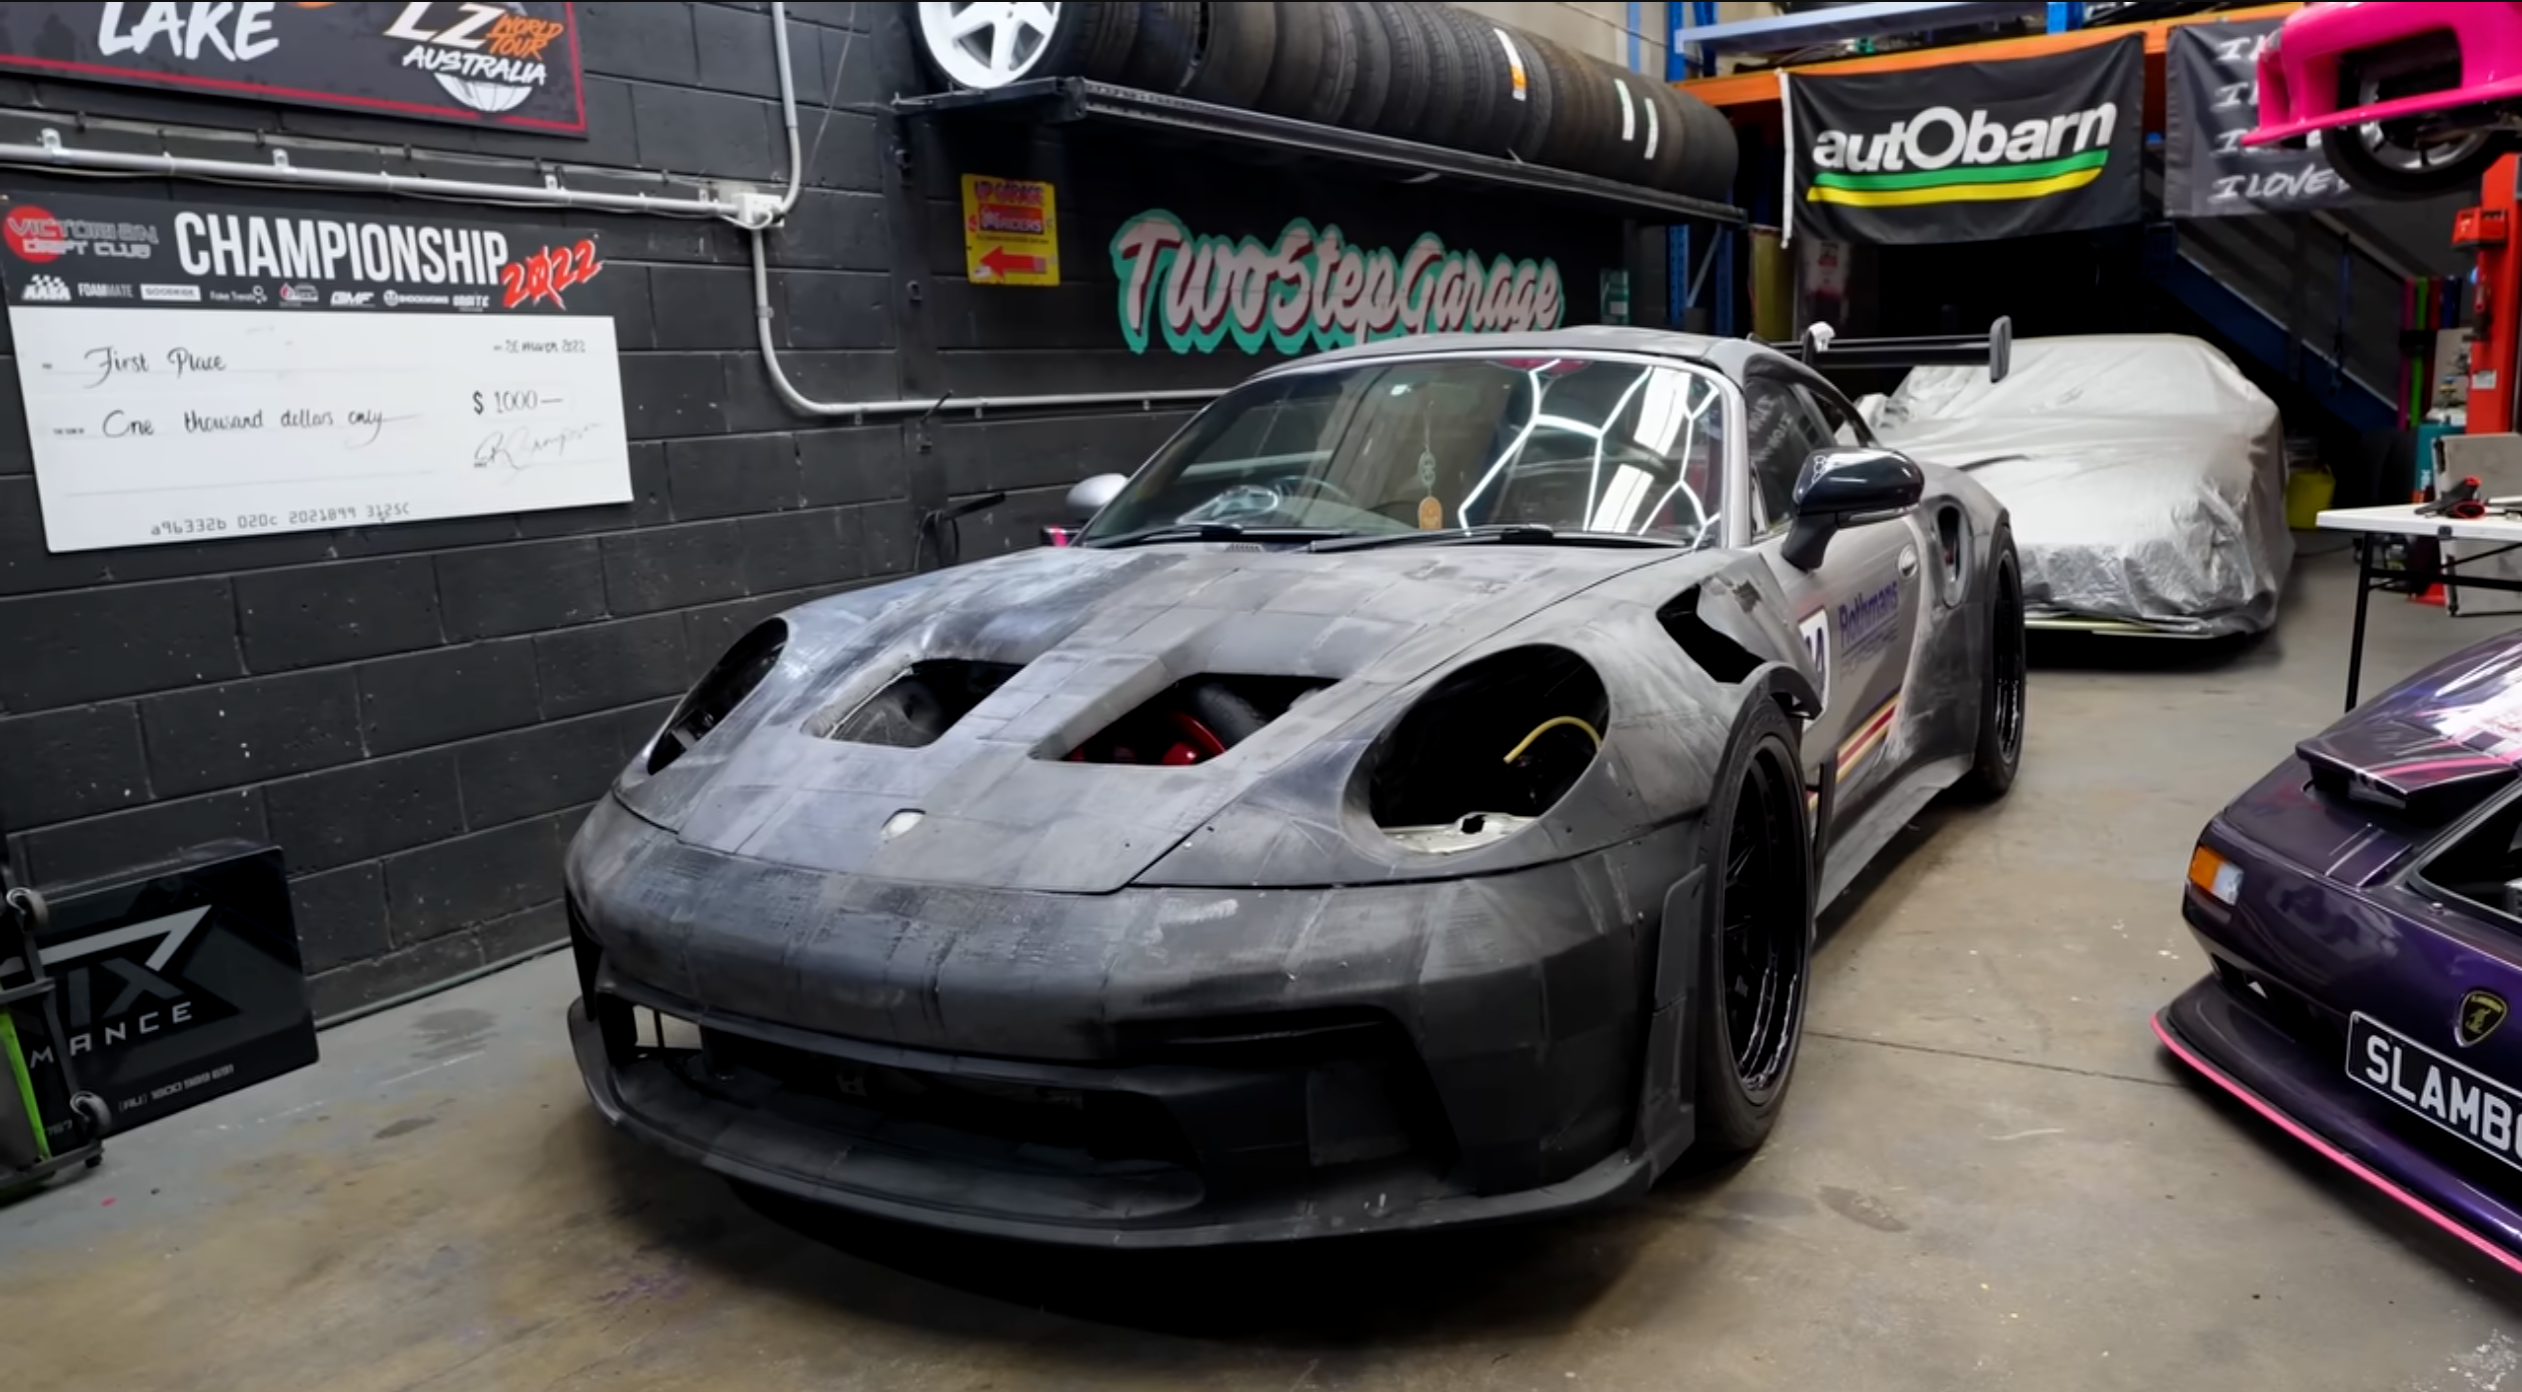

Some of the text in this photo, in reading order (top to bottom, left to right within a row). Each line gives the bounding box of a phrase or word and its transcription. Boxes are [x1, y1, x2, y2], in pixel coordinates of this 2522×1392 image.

[98, 0, 279, 62] LAKE
[382, 0, 506, 50] LZ
[487, 13, 564, 41] WORLD
[402, 45, 547, 86] AUSTRALIA
[488, 36, 543, 61] TOUR
[2207, 175, 2246, 203] I
[2245, 164, 2335, 198] LOVE
[93, 242, 151, 258] CLUB
[174, 211, 509, 286] CHAMPIONSHIP
[83, 345, 226, 389] First Place
[184, 408, 263, 433] thousand
[280, 409, 334, 430] dollars
[343, 409, 387, 450] only
